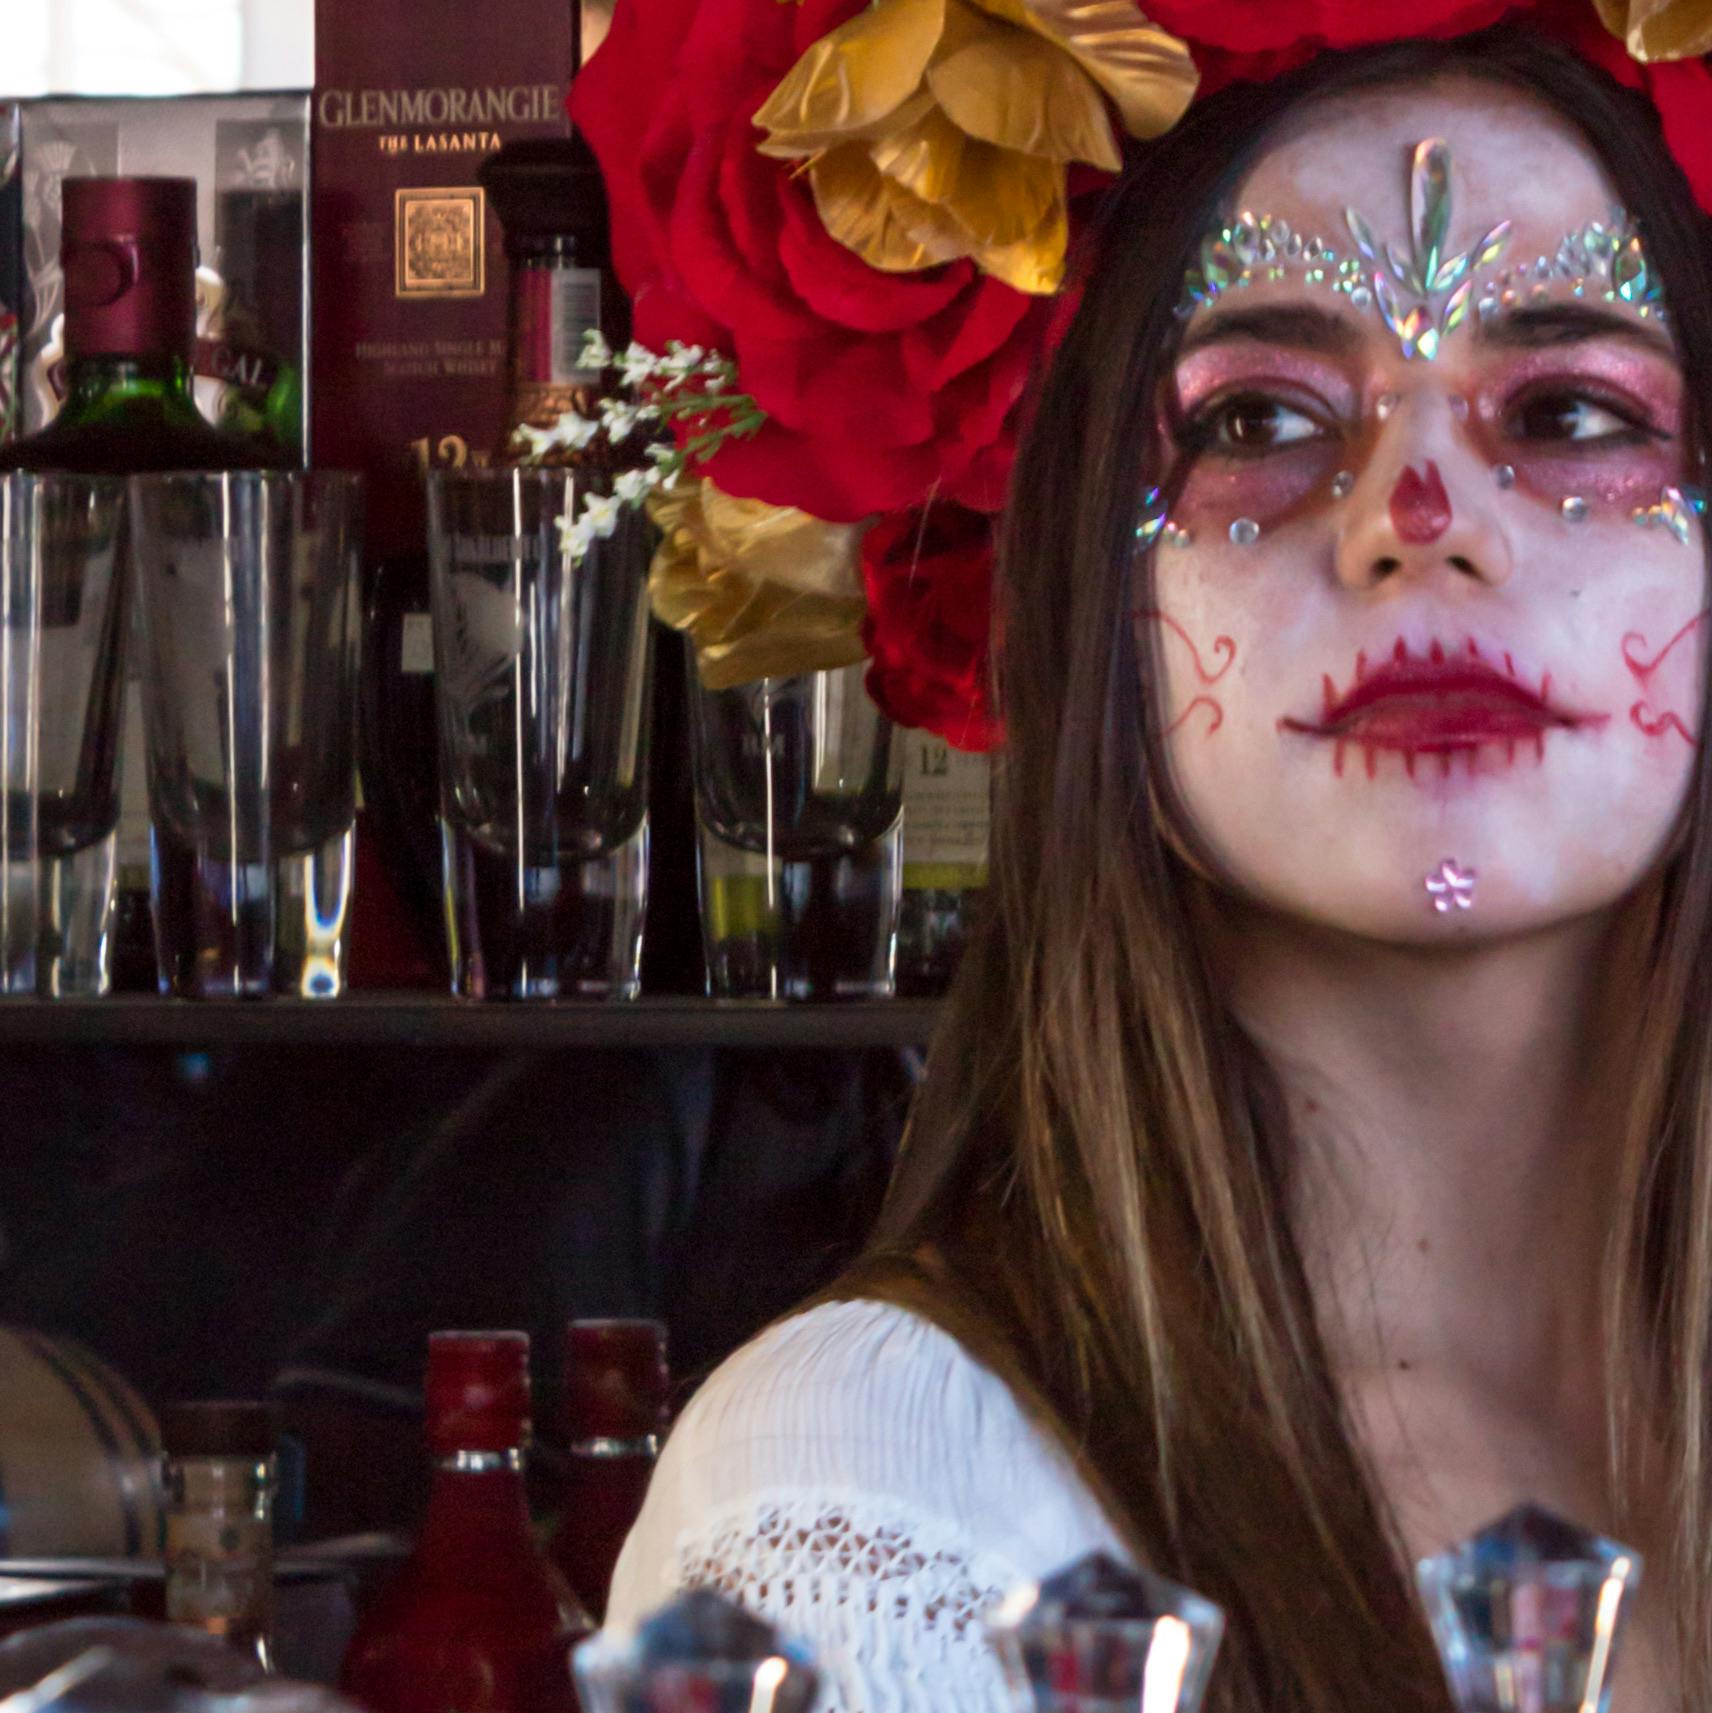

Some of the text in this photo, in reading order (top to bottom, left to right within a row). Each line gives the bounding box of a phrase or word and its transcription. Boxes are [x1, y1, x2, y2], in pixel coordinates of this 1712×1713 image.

[318, 86, 560, 129] GLENMORANGIE
[379, 132, 502, 154] THE LASANTA
[921, 742, 947, 776] 12
